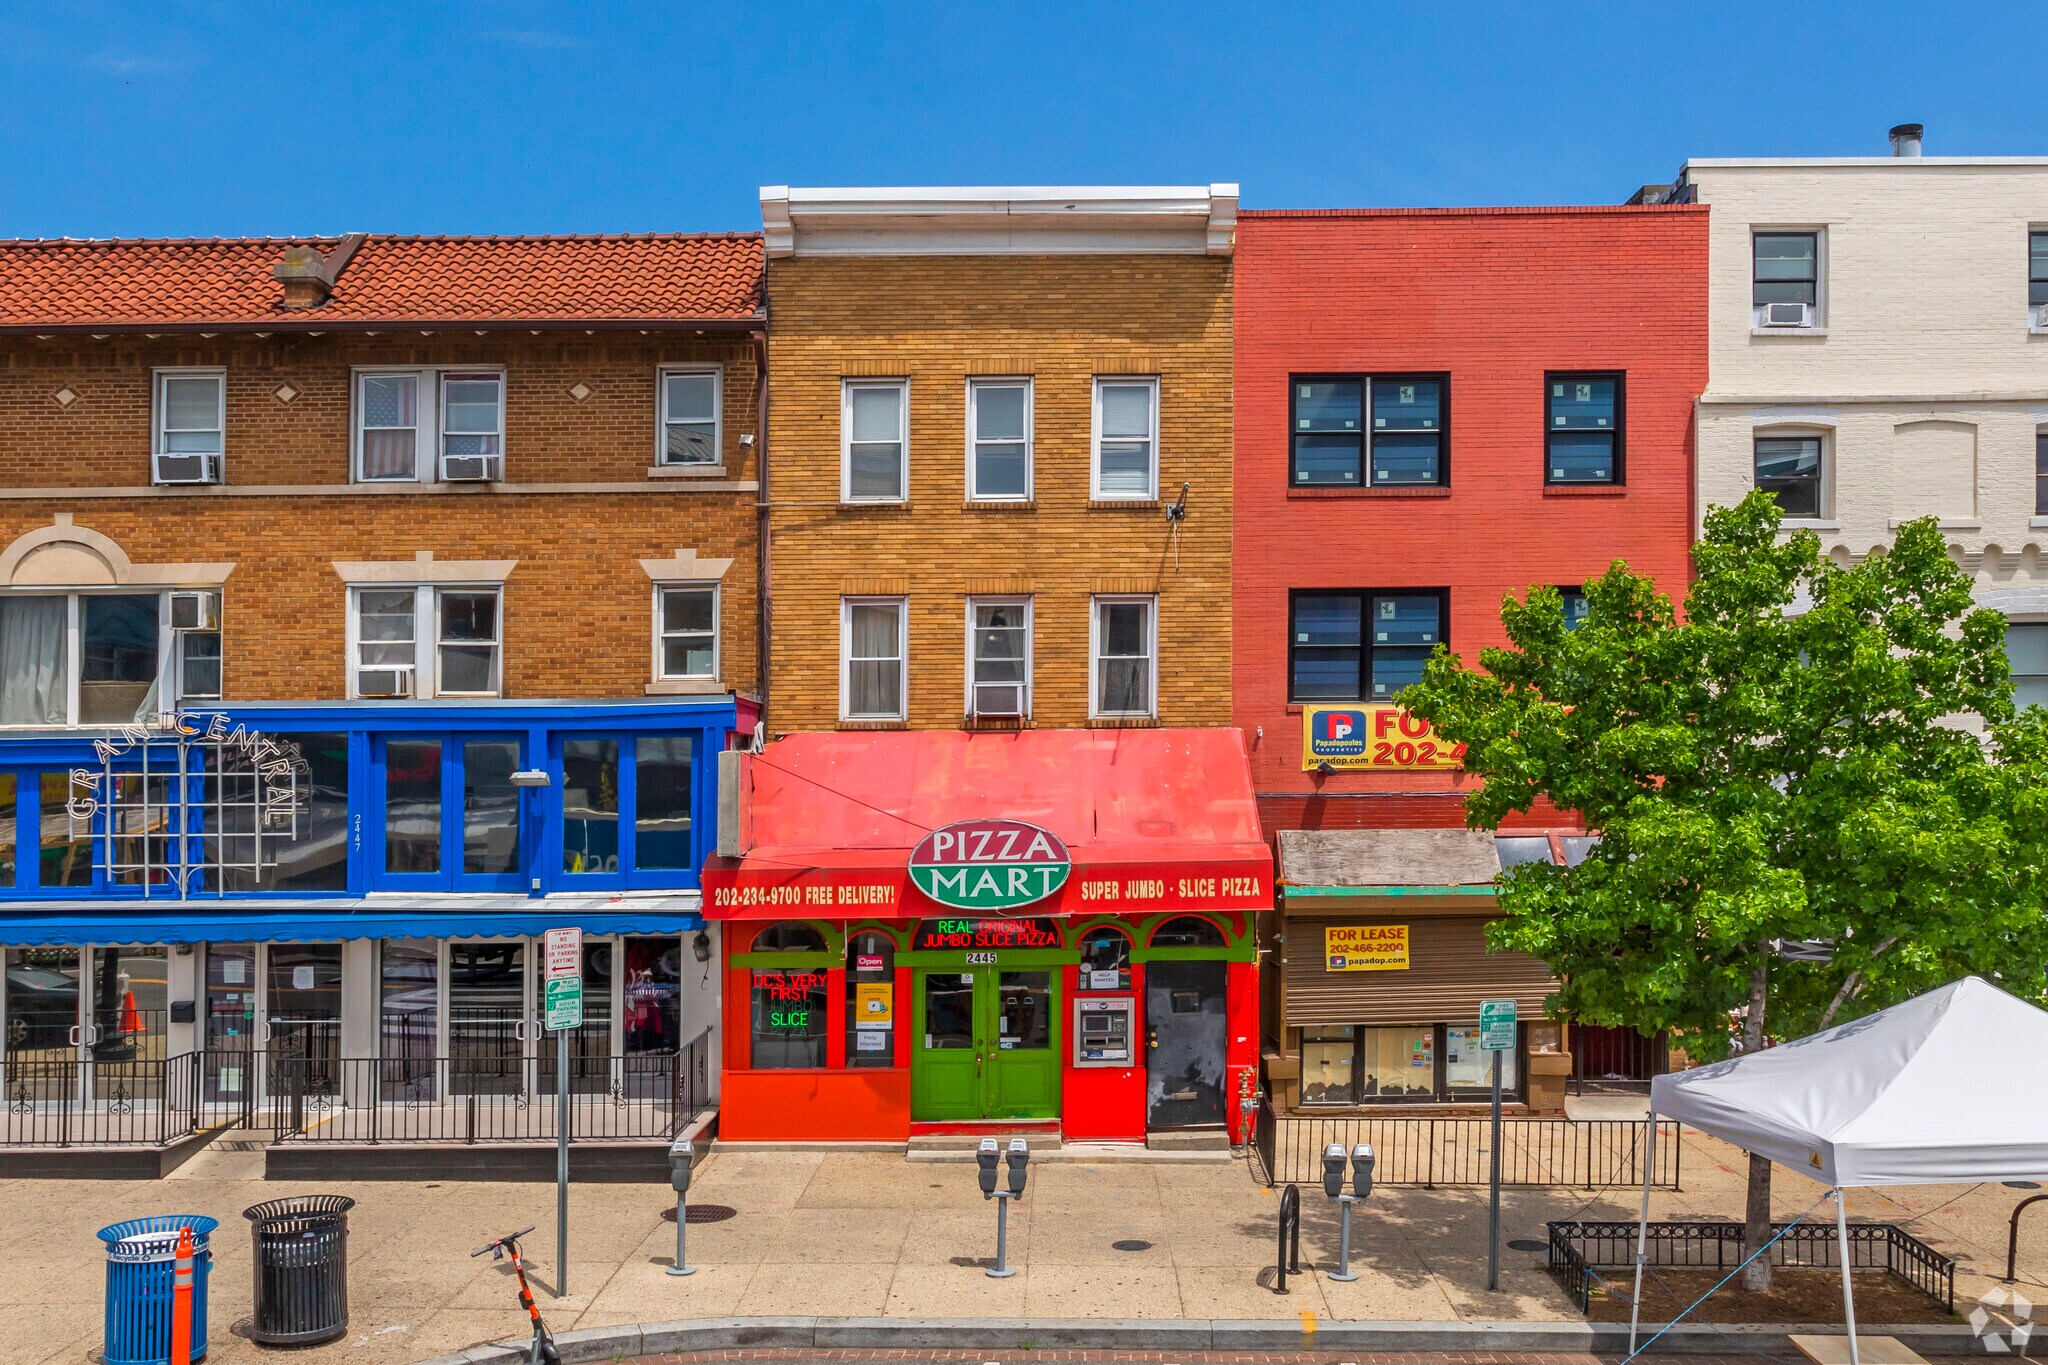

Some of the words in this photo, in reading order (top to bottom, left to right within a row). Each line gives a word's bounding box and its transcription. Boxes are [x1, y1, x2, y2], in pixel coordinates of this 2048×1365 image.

[1375, 709, 1440, 738] FO
[1315, 739, 1362, 748] Papadopoulos
[1308, 756, 1368, 766] papadop.com
[174, 712, 296, 825] CENTRAL
[933, 830, 1058, 861] PIZZA
[930, 868, 1060, 898] MART
[1081, 880, 1119, 900] SUPER
[1126, 879, 1164, 899] JUMBO
[1178, 878, 1216, 898] SLICE
[1222, 878, 1260, 896] PIZZA
[715, 886, 801, 906] 202-234-9700
[805, 886, 833, 904] FREE
[838, 886, 895, 904] DELIVERY!
[938, 920, 973, 934] REAL
[979, 920, 1041, 934] ORIGINAL
[924, 934, 970, 948] JUMBO
[976, 933, 1012, 946] SLICE
[1017, 932, 1056, 946] PIZZA
[1330, 930, 1356, 940] FOR
[1361, 928, 1405, 940] LEASE
[1330, 943, 1404, 953] 202-466-2200
[858, 958, 882, 966] Open
[967, 953, 996, 964] 2445
[1348, 956, 1406, 966] papadop.com
[754, 974, 785, 988] DC'S
[790, 974, 827, 988] VERY
[771, 987, 809, 1000] FIRST
[771, 1013, 808, 1026] SLICE
[113, 1254, 139, 1262] Recycle
